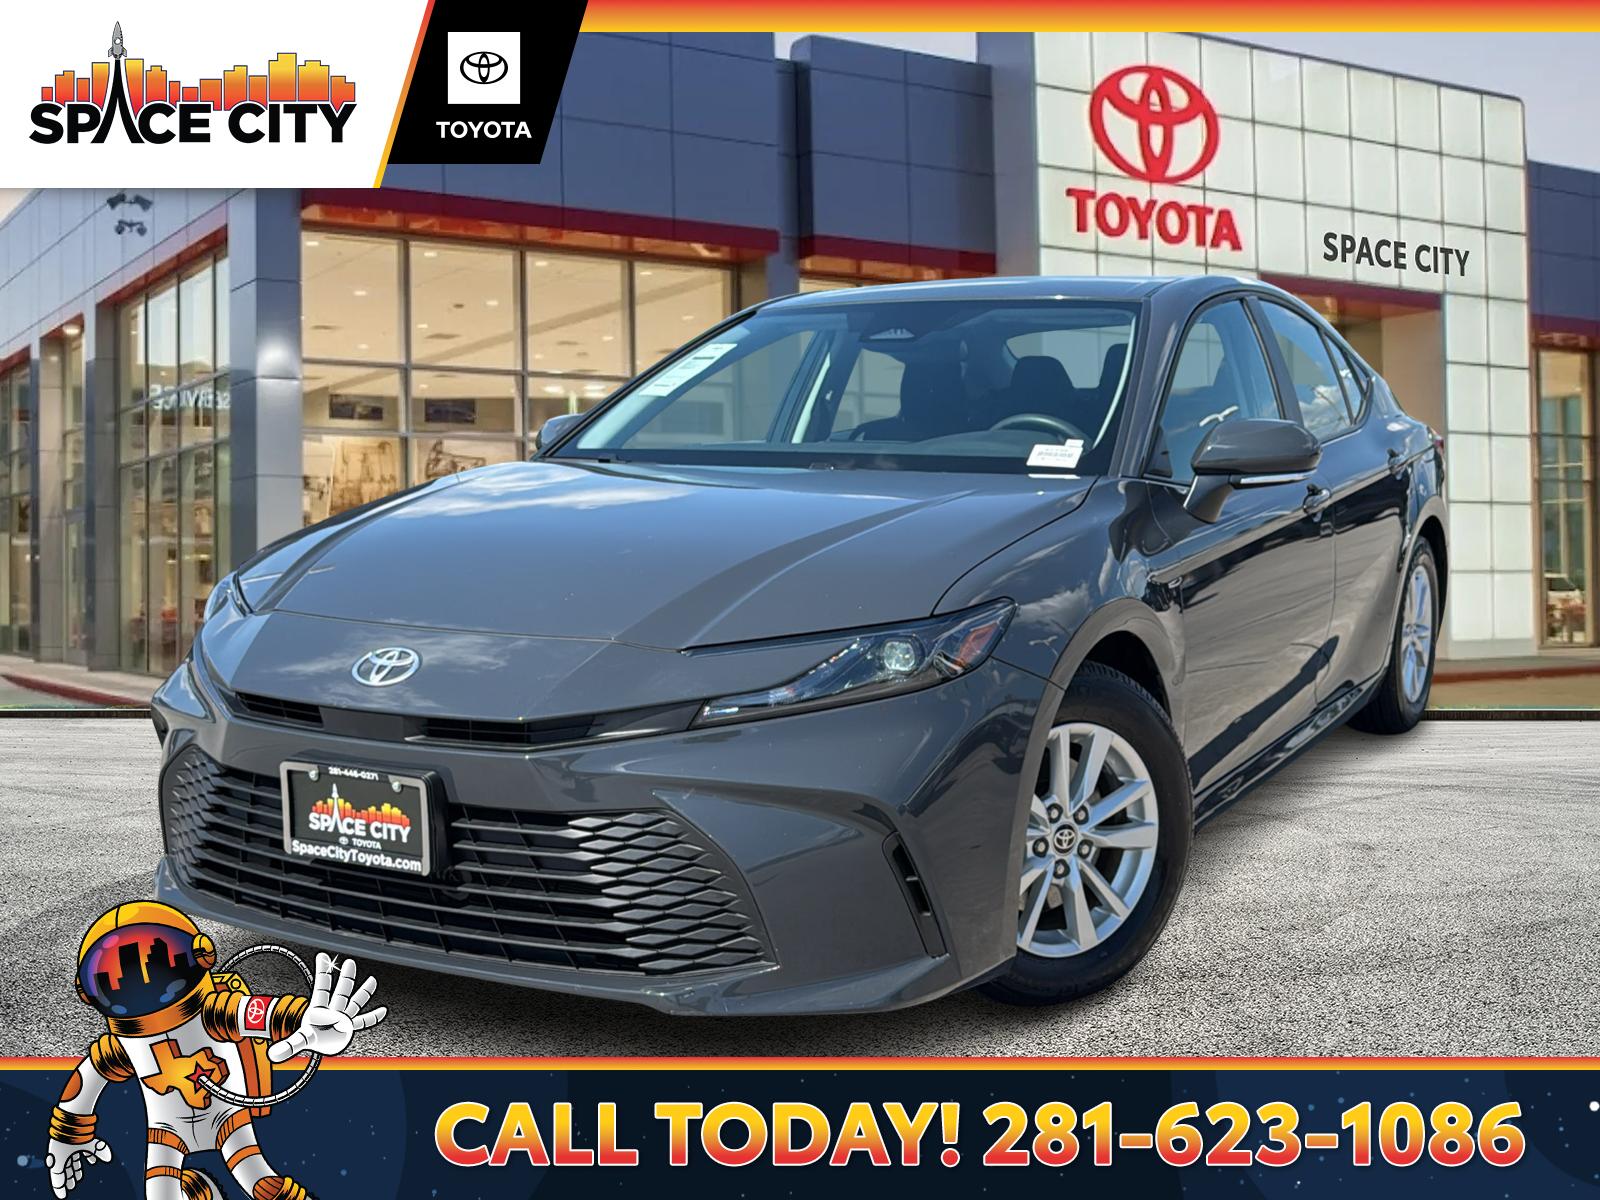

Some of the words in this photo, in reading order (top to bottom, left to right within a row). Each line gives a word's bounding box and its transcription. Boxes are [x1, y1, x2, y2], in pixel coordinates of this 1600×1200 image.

[1066, 187, 1242, 251] TOYOTA
[1323, 232, 1407, 270] SPACE
[1414, 244, 1470, 277] CITY
[308, 812, 366, 837] SPACE
[370, 823, 411, 842] CITY
[291, 839, 422, 872] SpaceCityToyota.com
[352, 838, 382, 850] TOYOTA
